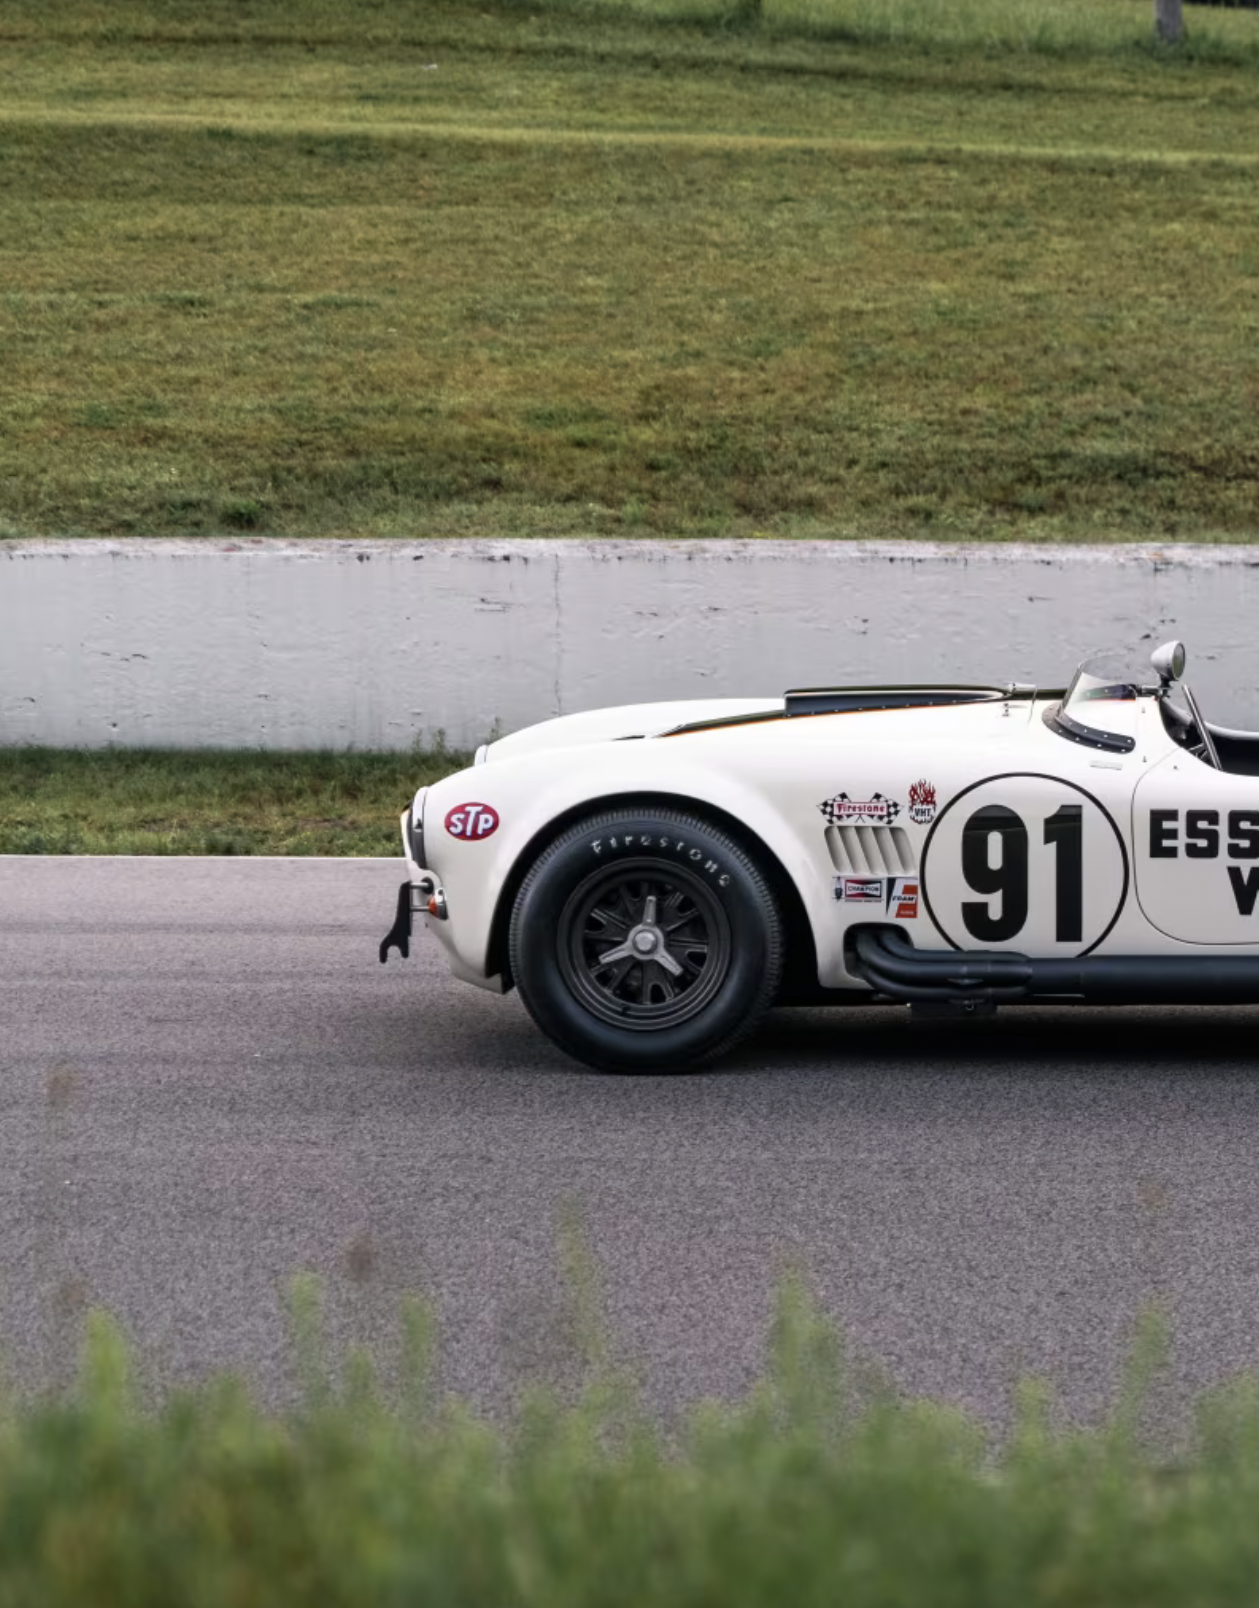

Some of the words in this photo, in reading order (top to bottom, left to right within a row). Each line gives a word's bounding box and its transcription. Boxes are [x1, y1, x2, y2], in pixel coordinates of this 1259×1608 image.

[837, 803, 886, 813] Firestone
[914, 807, 932, 818] VHT
[448, 805, 494, 836] STP
[961, 804, 1082, 943] 91
